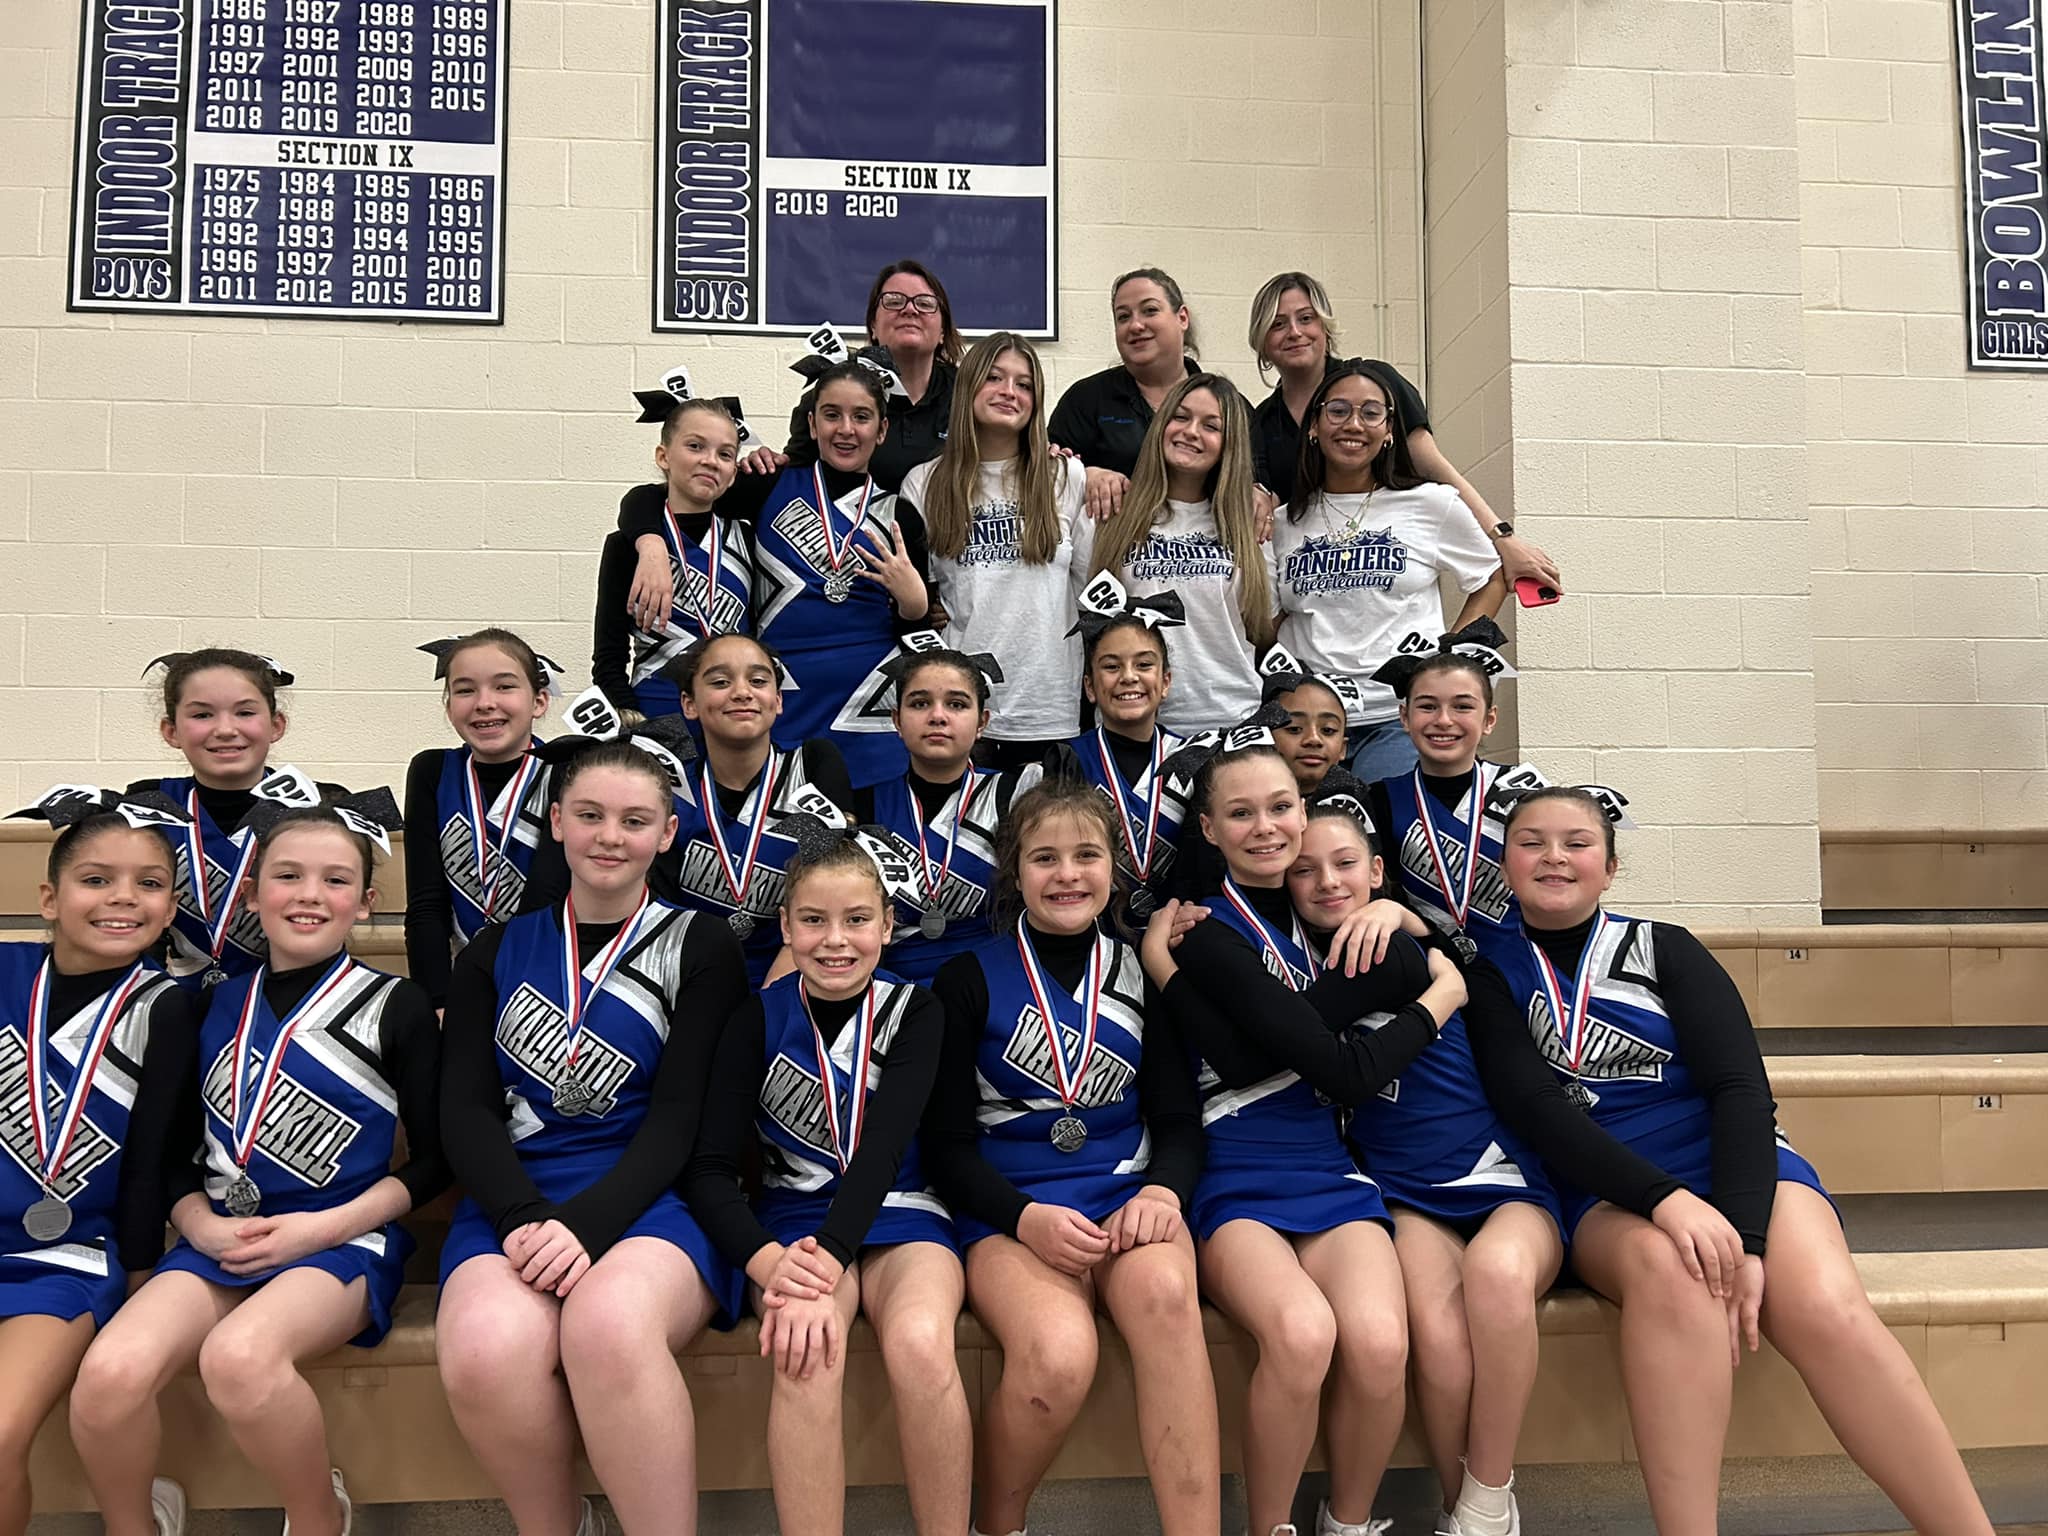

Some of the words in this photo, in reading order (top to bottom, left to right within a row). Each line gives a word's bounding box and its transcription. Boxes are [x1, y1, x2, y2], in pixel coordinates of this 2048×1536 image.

[212, 0, 266, 20] 1986
[285, 0, 340, 24] 1987
[359, 3, 413, 26] 1988
[433, 6, 487, 30] 1989
[102, 0, 184, 107] TRAC
[210, 24, 264, 47] 1991
[284, 27, 339, 50] 1992
[358, 30, 413, 54] 1993
[432, 33, 486, 57] 1996
[209, 51, 264, 74] 1997
[283, 54, 337, 77] 2001
[358, 57, 412, 81] 2009
[432, 61, 485, 84] 2010
[677, 8, 752, 134] TRACK
[208, 78, 262, 101] 2011
[282, 80, 337, 104] 2012
[357, 84, 411, 108] 2013
[431, 87, 485, 111] 2015
[206, 105, 262, 129] 2018
[281, 107, 338, 132] 2019
[356, 112, 411, 135] 2020
[279, 141, 377, 166] SECTION
[389, 145, 413, 167] IX
[94, 115, 177, 255] INDOOR
[204, 168, 260, 192] 1975
[280, 171, 334, 195] 1984
[354, 174, 409, 198] 1985
[429, 177, 483, 201] 1986
[845, 166, 937, 189] SECTION
[949, 169, 970, 190] IX
[203, 195, 259, 219] 1987
[279, 198, 334, 221] 1988
[354, 200, 409, 224] 1989
[429, 204, 482, 227] 1991
[675, 141, 751, 278] INDOOR
[776, 192, 827, 215] 2019
[846, 194, 897, 217] 2020
[201, 221, 258, 245] 1992
[277, 224, 333, 248] 1993
[353, 227, 408, 251] 1994
[428, 230, 482, 254] 1995
[93, 257, 171, 299] BOYS
[201, 248, 257, 272] 1996
[277, 251, 333, 275] 1997
[352, 254, 407, 278] 2001
[427, 257, 481, 280] 2010
[200, 276, 256, 300] 2011
[276, 279, 332, 302] 2012
[352, 281, 407, 304] 2015
[426, 284, 481, 306] 2018
[675, 280, 748, 320] BOYS
[1982, 321, 2048, 358] GIRLS
[957, 546, 1025, 565] Cheerlea
[1124, 541, 1235, 567] PANTHER
[1133, 560, 1234, 580] Cheerleading
[1285, 545, 1407, 583] PANTHERS
[1292, 573, 1396, 593] Cheerleading
[441, 818, 525, 922] WALLKIL
[682, 843, 787, 915] WALKIL
[1790, 949, 1801, 960] 14
[1003, 1007, 1136, 1108] WALKIL
[203, 1039, 359, 1187] WLKILL
[1979, 1096, 1992, 1108] 14
